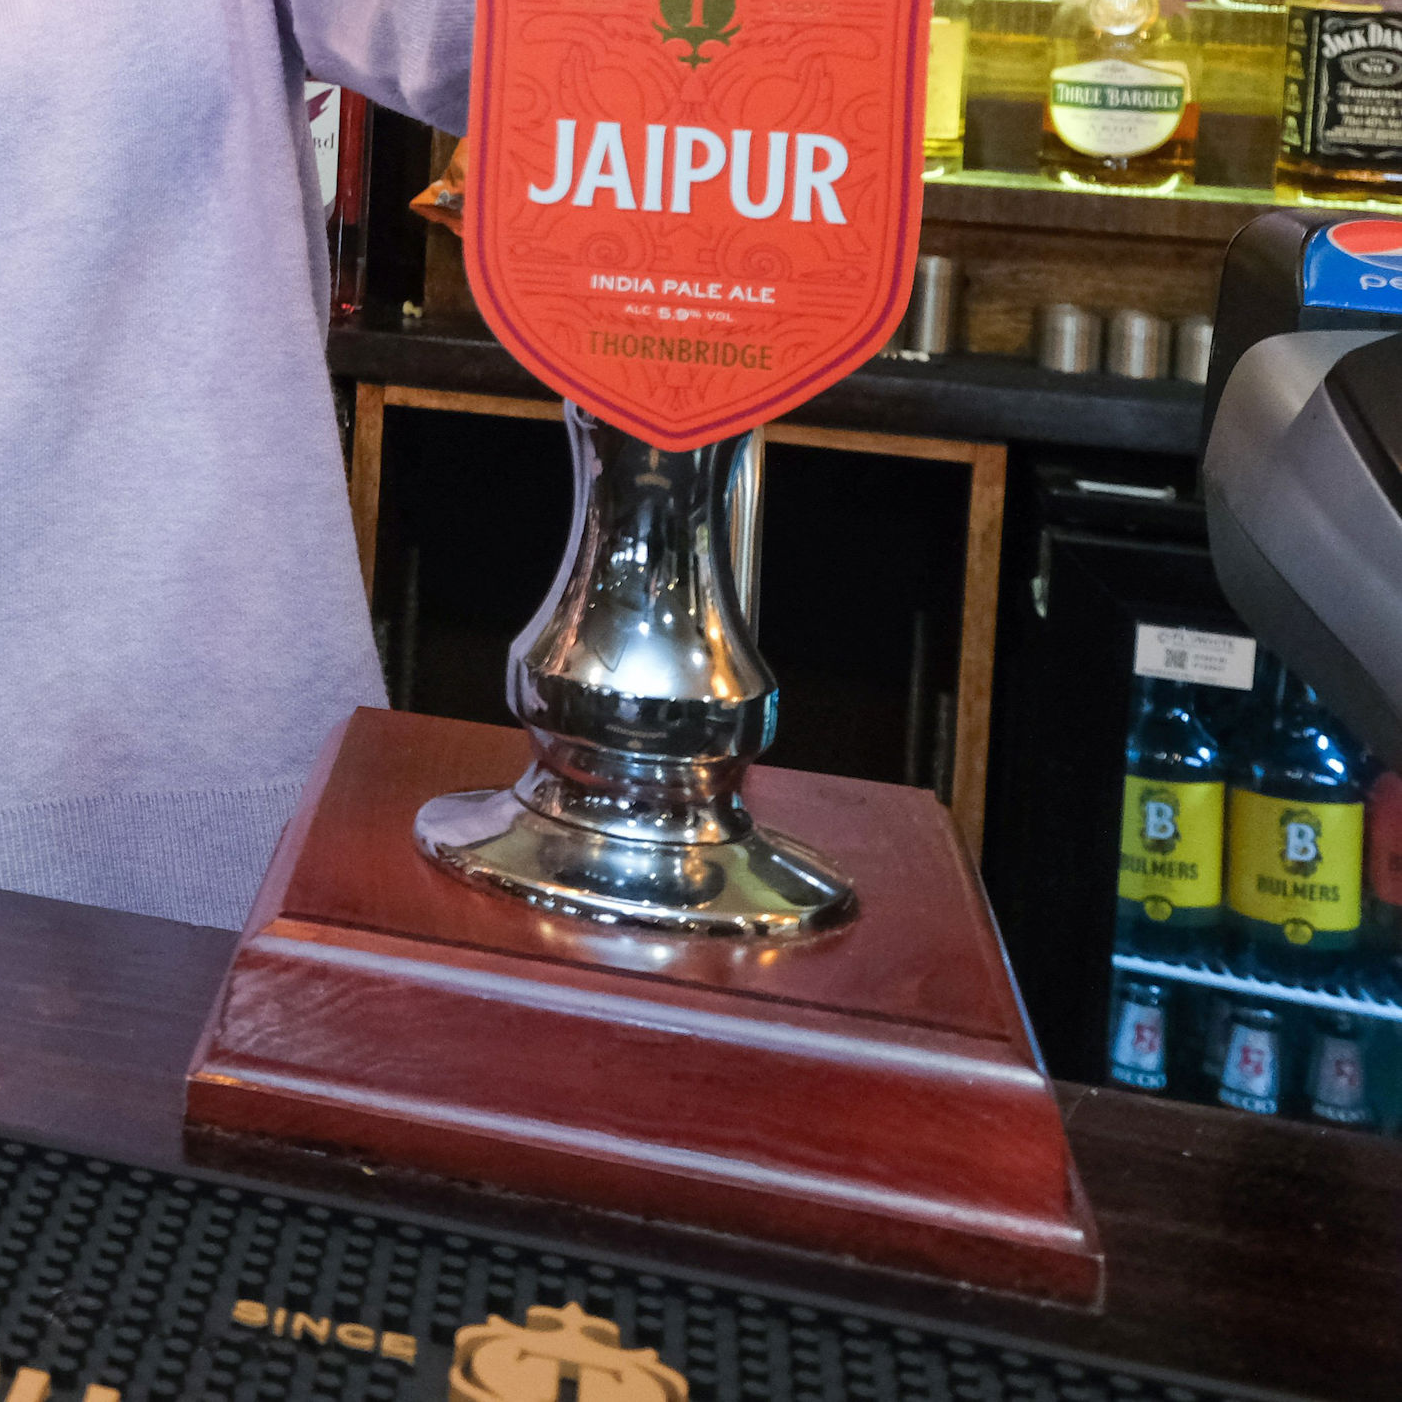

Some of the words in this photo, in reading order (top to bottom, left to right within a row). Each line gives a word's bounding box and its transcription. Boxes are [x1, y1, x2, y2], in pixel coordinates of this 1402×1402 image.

[1321, 28, 1368, 59] JACK
[1056, 82, 1102, 105] THREE
[1107, 87, 1179, 108] BARRELS
[527, 118, 850, 225] JAIPUR
[590, 274, 656, 294] INDIA
[662, 279, 724, 300] PALE
[727, 285, 776, 304] ALE
[624, 304, 652, 316] ALC
[656, 306, 702, 322] 5.9%
[589, 330, 774, 371] THORNBRIDGE
[1145, 801, 1176, 840] B
[1285, 821, 1318, 862] B
[1120, 853, 1199, 882] BULMERS
[1256, 873, 1341, 903] BULMERS
[230, 1298, 417, 1366] SINCE
